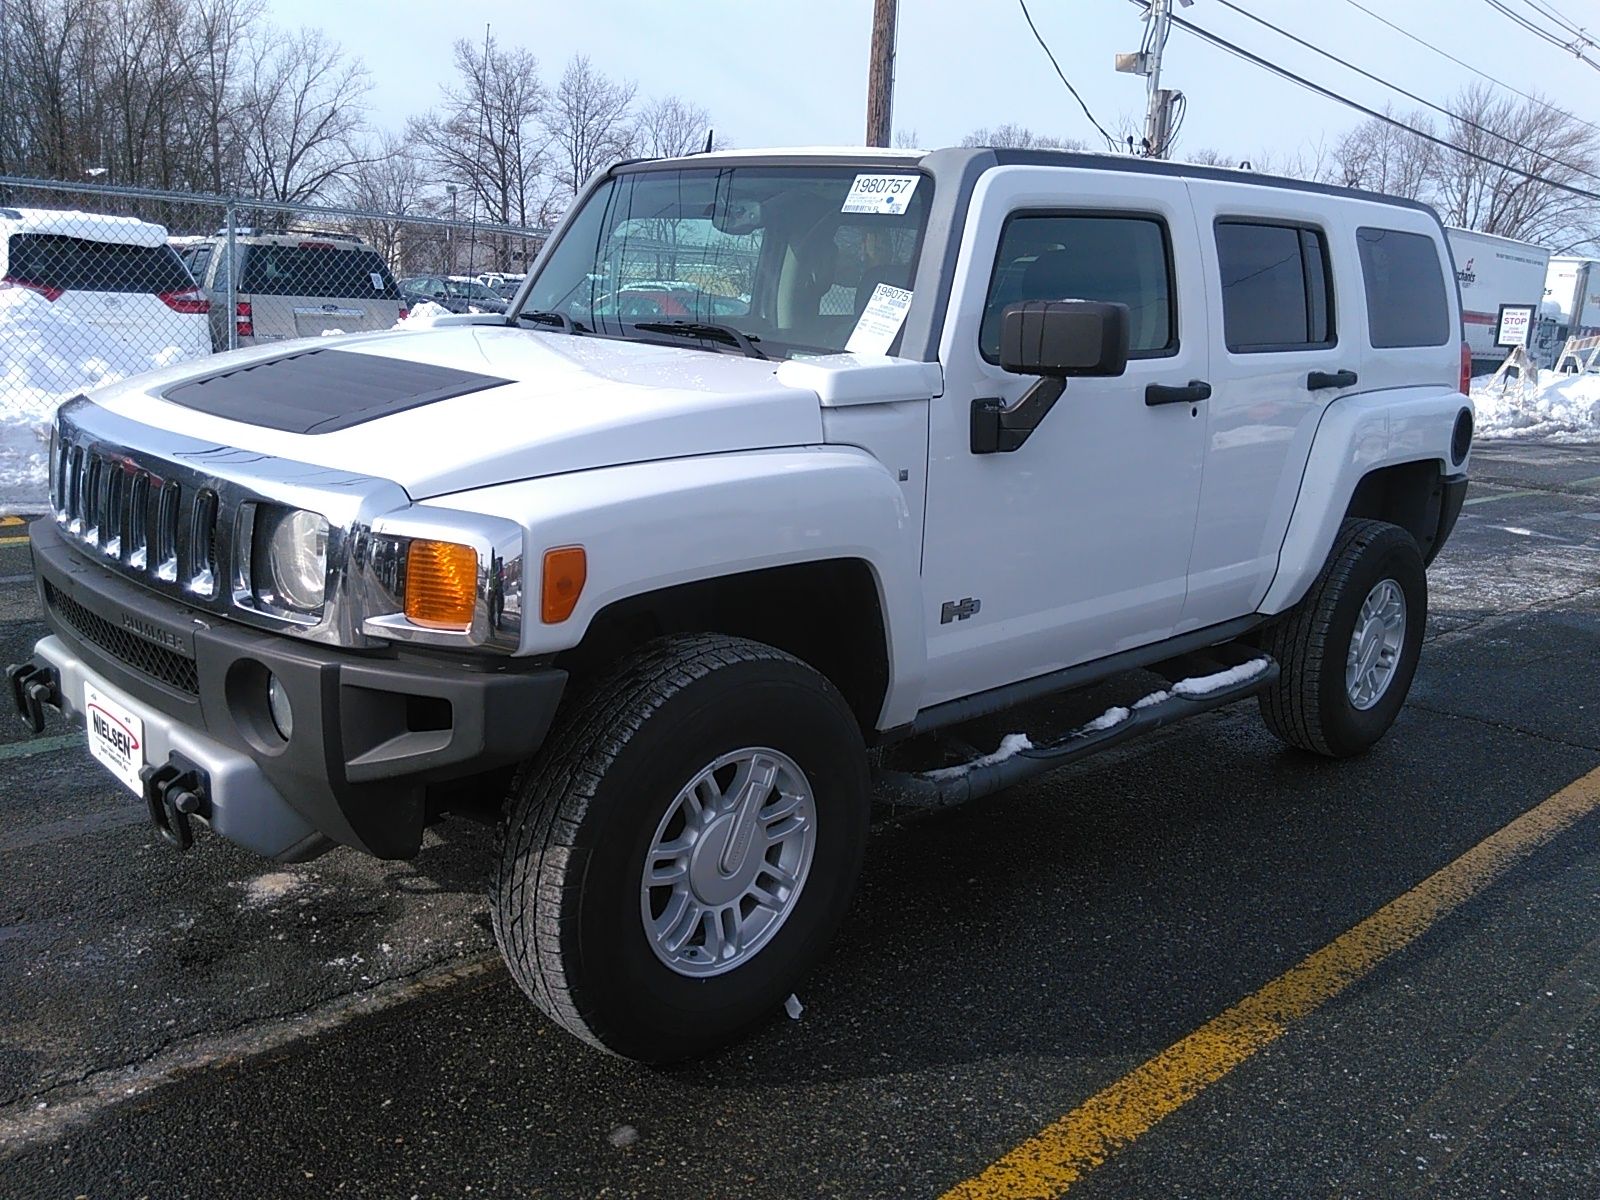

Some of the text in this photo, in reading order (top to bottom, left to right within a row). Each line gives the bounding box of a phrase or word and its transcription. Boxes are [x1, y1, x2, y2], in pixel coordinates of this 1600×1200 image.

[854, 178, 912, 194] 1980757
[1503, 317, 1527, 325] STOP
[940, 597, 981, 625] H3
[92, 709, 132, 761] NIELSEN
